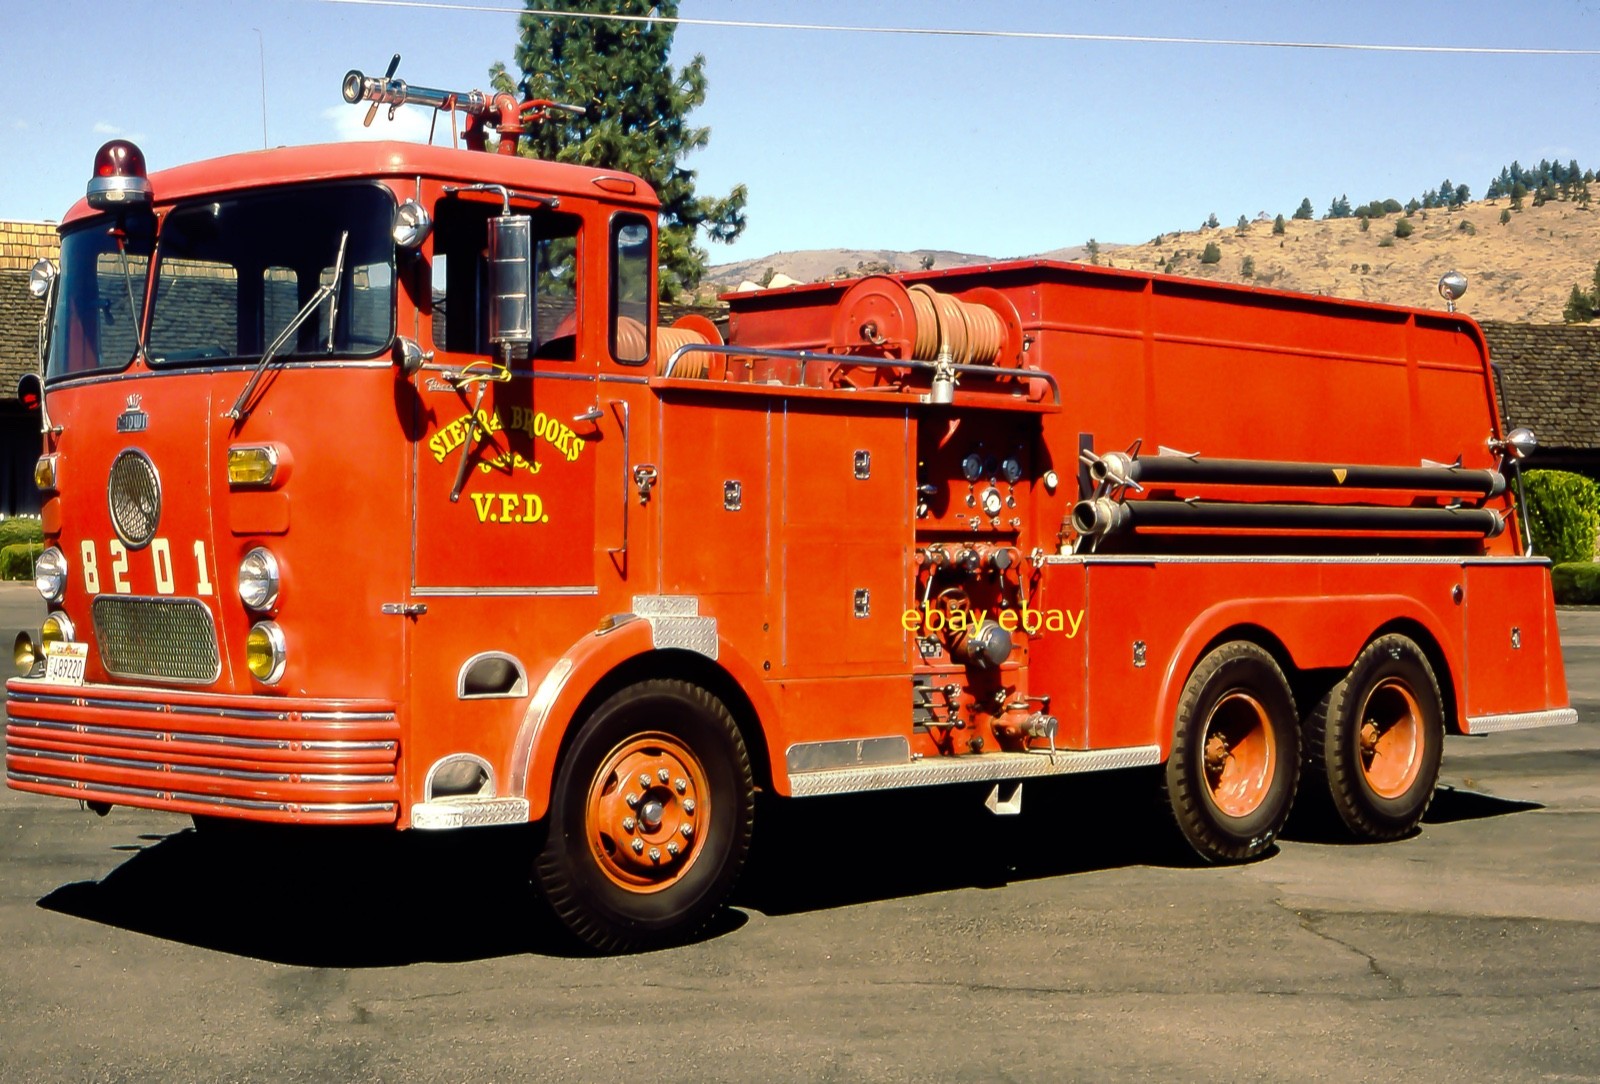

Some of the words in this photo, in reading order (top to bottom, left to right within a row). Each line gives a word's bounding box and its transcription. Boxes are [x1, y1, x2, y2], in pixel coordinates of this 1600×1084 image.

[511, 406, 586, 462] BROOKS
[470, 493, 549, 523] V.F.D.
[53, 658, 83, 679] 489220
